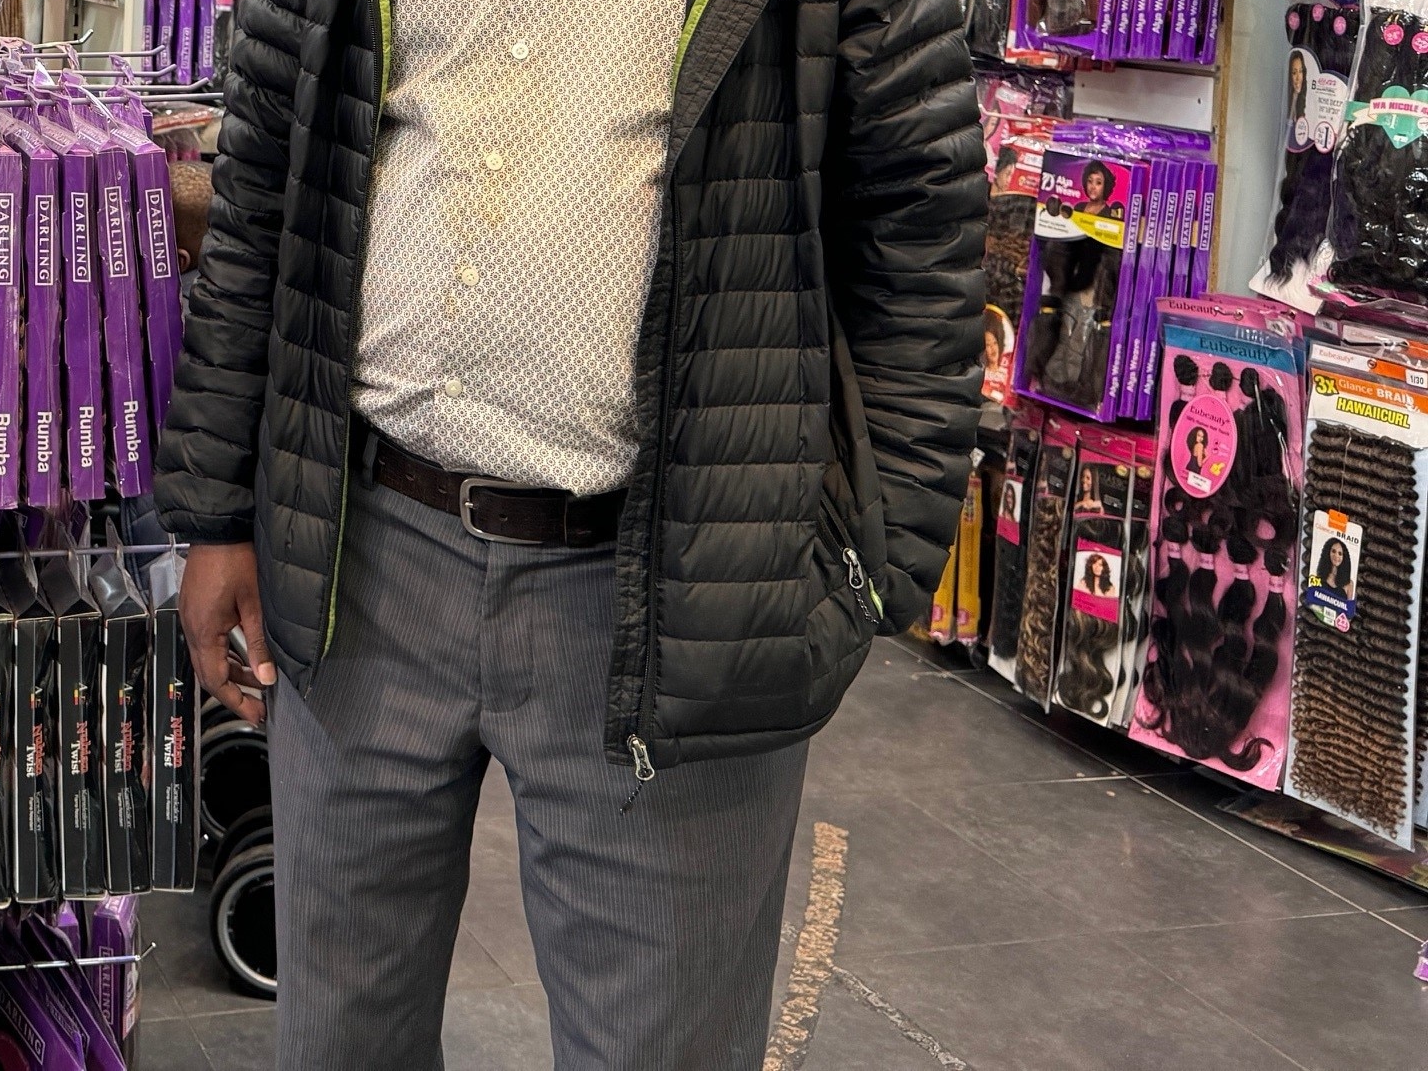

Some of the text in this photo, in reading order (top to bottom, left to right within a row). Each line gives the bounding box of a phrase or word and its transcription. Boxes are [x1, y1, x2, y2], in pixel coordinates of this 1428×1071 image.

[1056, 185, 1081, 199] Weave
[37, 198, 52, 282] DARLING
[73, 195, 89, 278] DARLING
[107, 190, 126, 273] DARLING
[147, 193, 168, 275] DARLING
[1112, 343, 1122, 376] Weave
[1130, 338, 1140, 371] Weave
[1147, 341, 1157, 373] Weave
[1199, 337, 1271, 363] Eubeauty
[1338, 379, 1373, 394] Glance
[1337, 397, 1411, 429] HAWAIICURL
[37, 411, 53, 473] Rumba
[78, 406, 94, 468] Rumba
[123, 400, 140, 463] Rumba
[1336, 531, 1359, 544] BRAID
[26, 744, 36, 778] Twist
[71, 740, 80, 775] Twist
[114, 740, 124, 774] Twist
[164, 734, 174, 768] Twist
